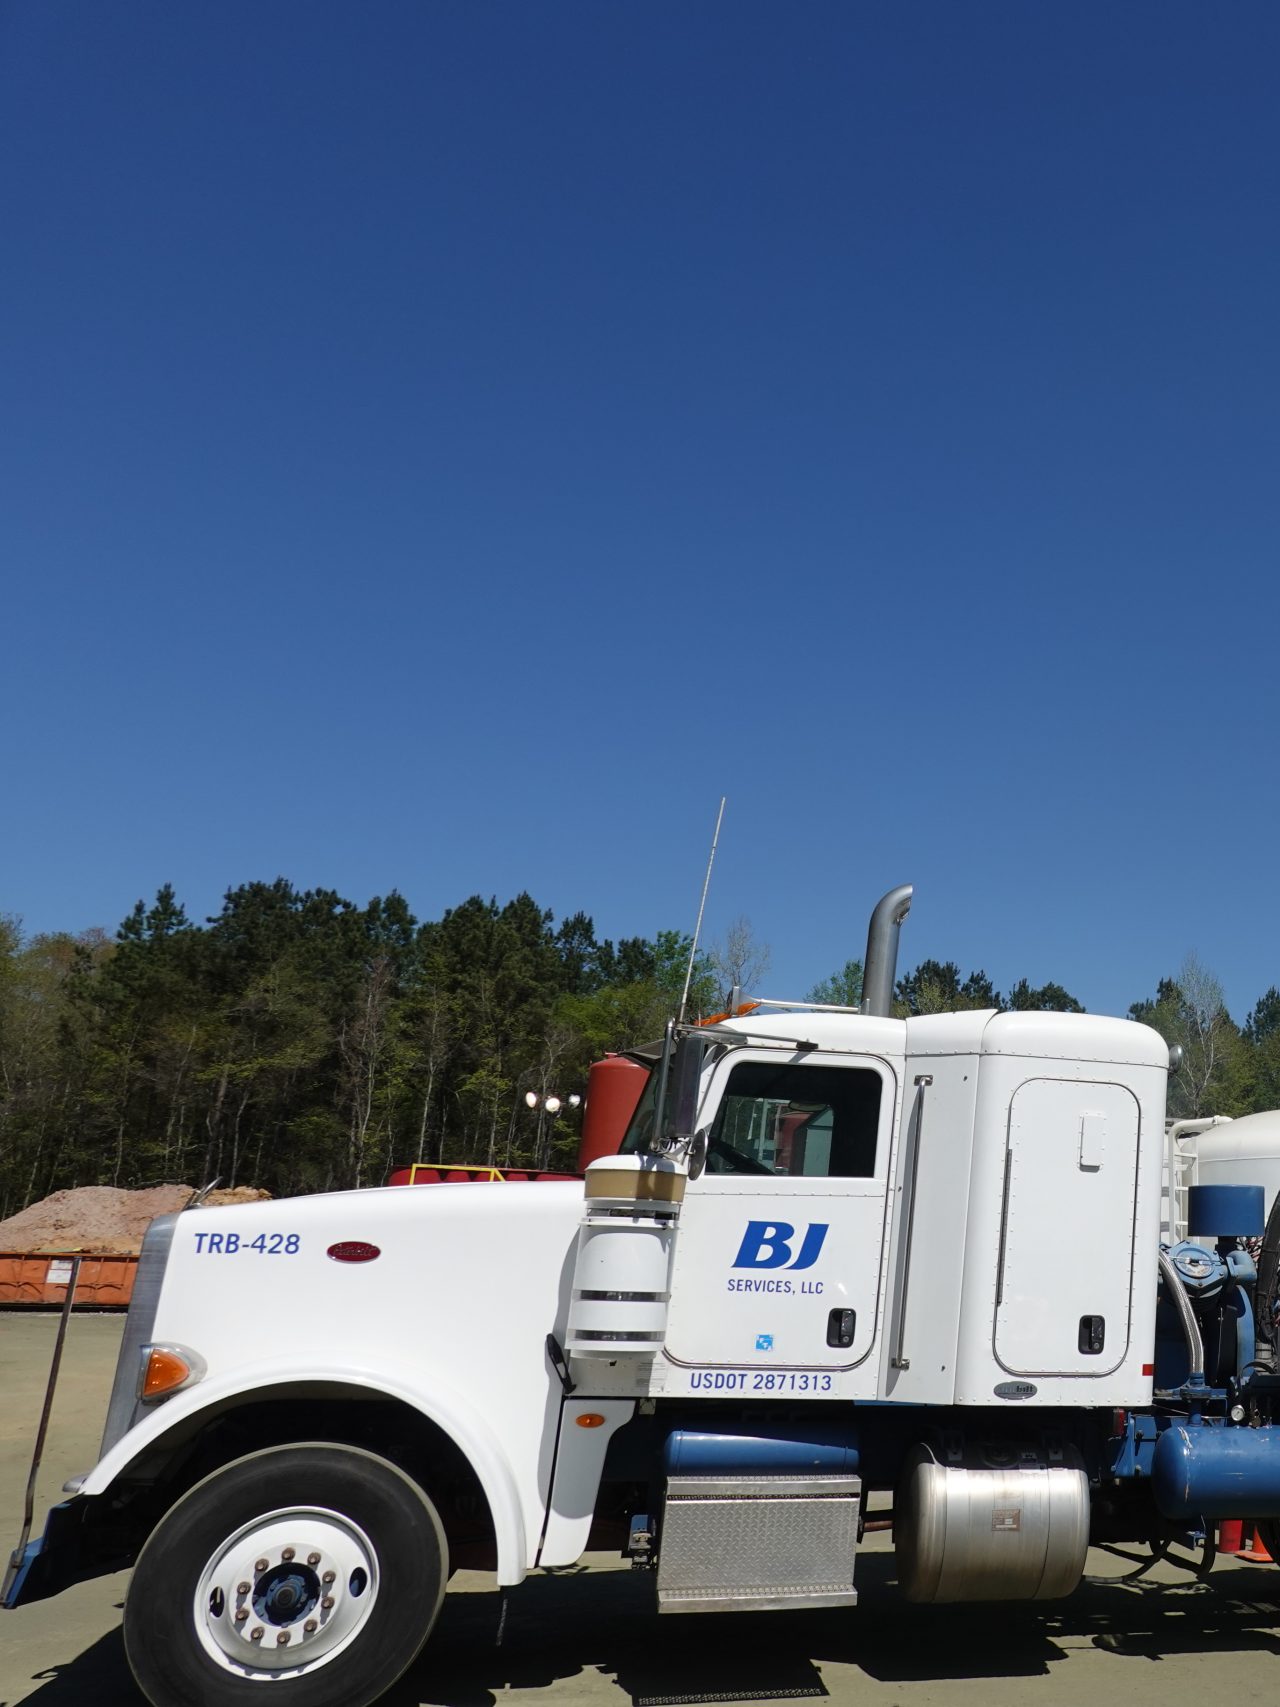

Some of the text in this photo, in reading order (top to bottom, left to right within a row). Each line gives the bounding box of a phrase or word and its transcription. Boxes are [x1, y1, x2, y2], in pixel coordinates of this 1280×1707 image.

[194, 1233, 300, 1255] TRB-428
[730, 1220, 830, 1271] BJ
[727, 1279, 824, 1296] SERVICES, LLC
[690, 1373, 832, 1391] USDOT 2871313
